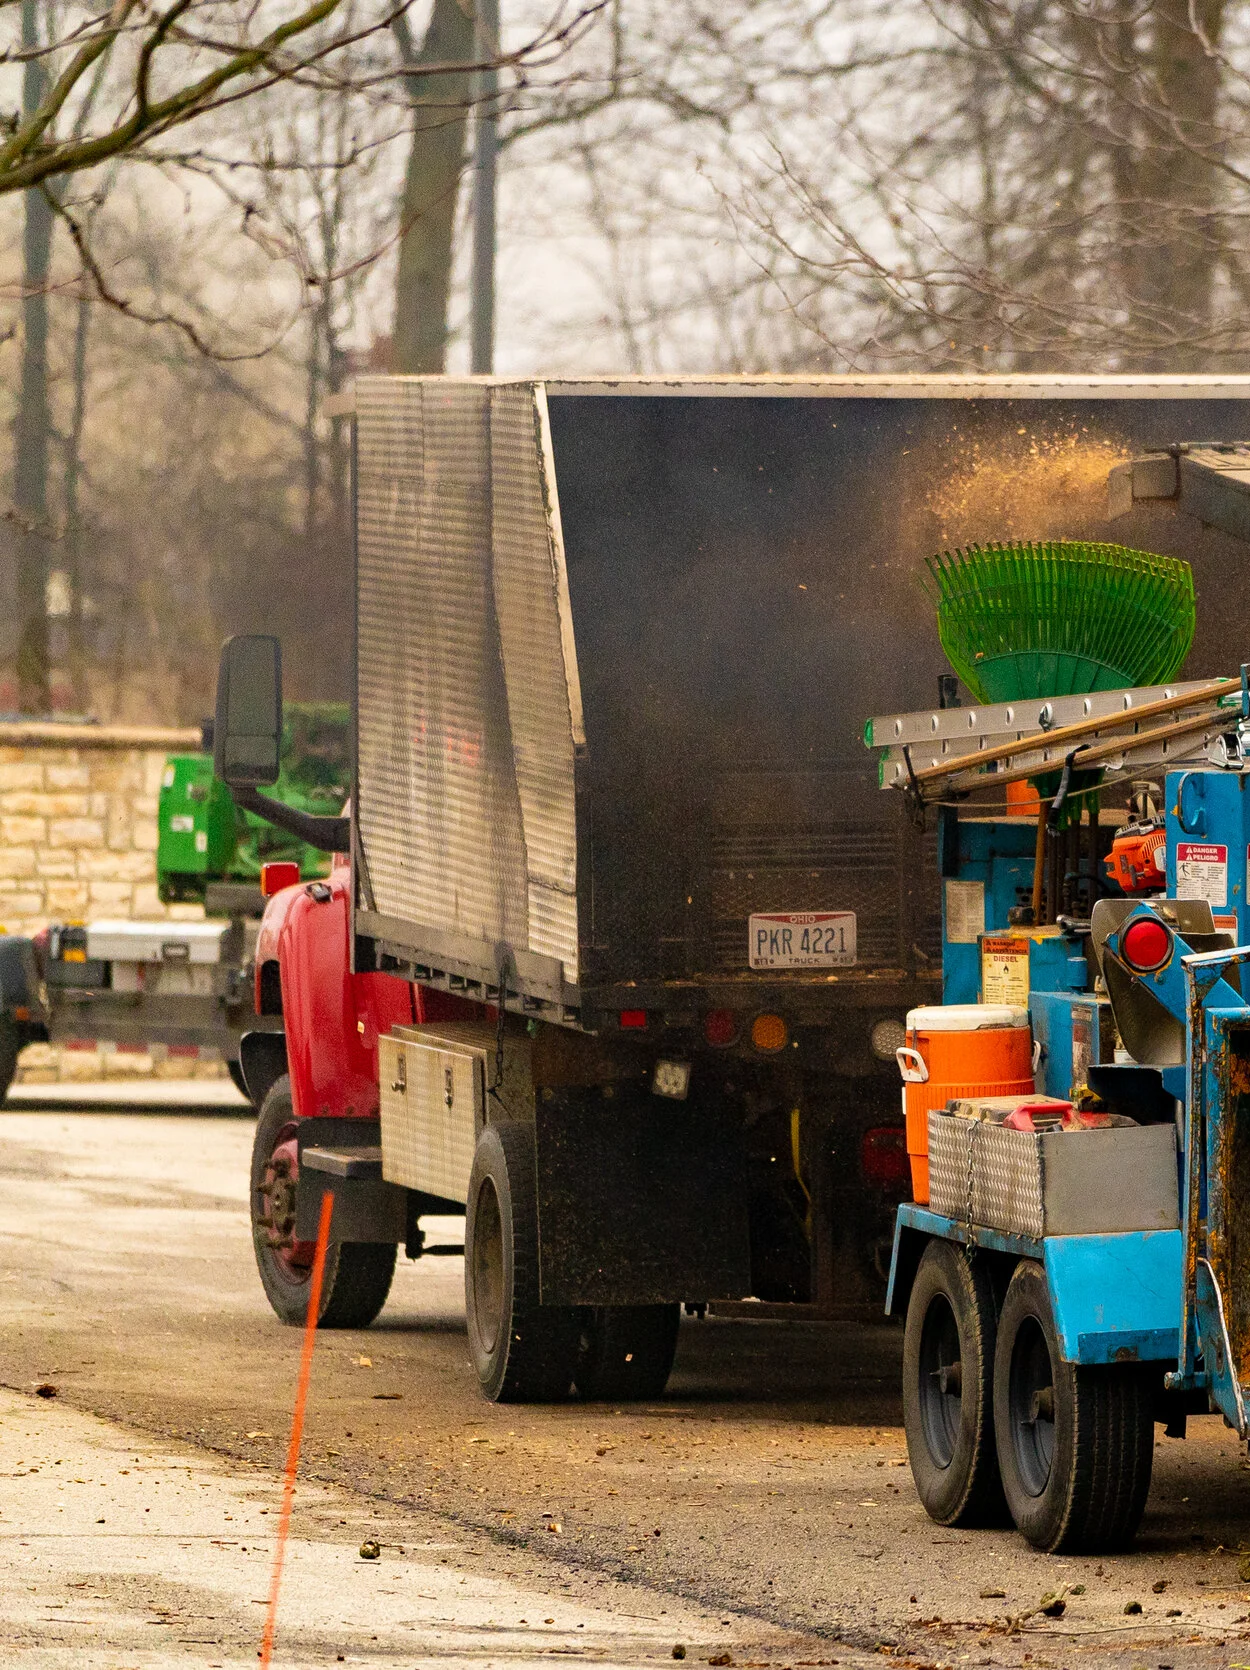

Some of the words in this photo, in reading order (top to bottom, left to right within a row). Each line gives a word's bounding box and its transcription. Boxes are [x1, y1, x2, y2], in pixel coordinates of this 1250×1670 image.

[789, 915, 816, 924] OHIO
[756, 928, 793, 956] PKR
[800, 927, 847, 954] 4221
[993, 955, 1018, 963] DIESEL
